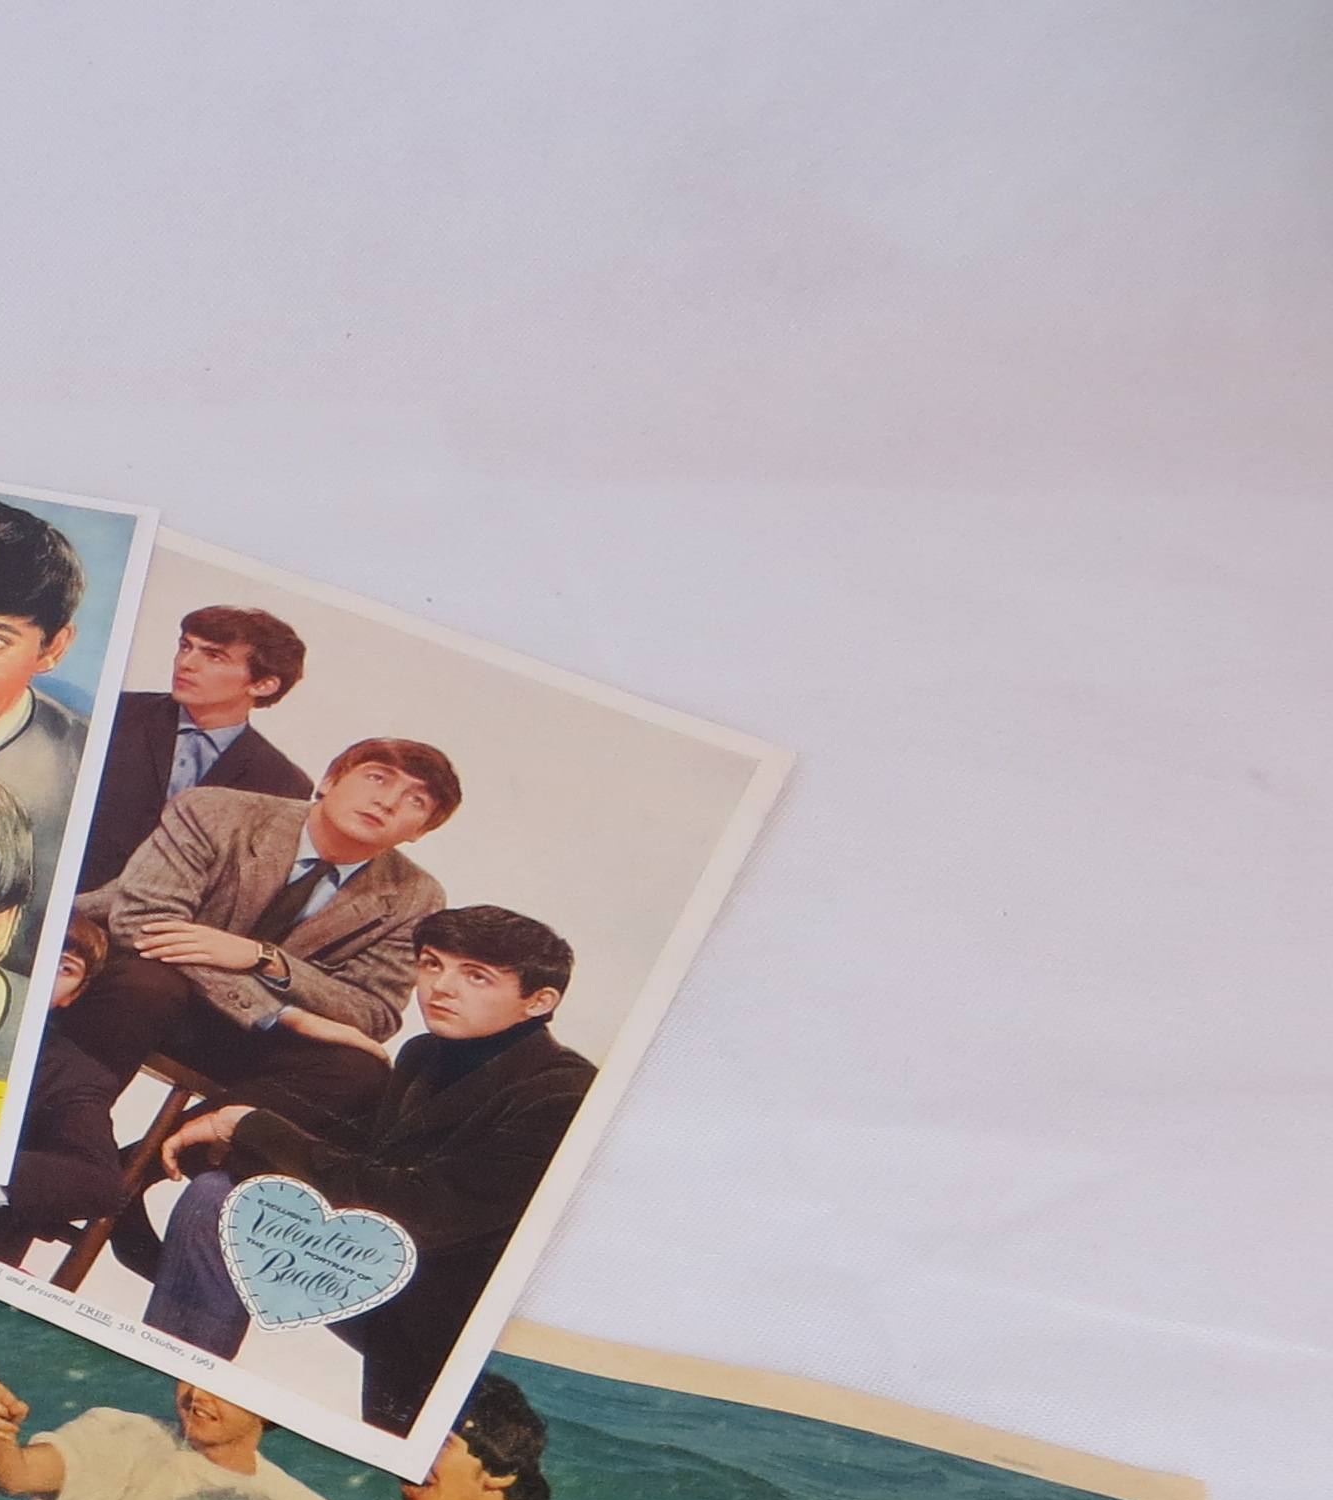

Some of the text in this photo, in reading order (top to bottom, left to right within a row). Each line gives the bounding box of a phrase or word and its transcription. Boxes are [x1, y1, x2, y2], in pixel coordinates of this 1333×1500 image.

[257, 1199, 311, 1225] EXCLUSIVE
[246, 1236, 267, 1249] THE
[251, 1207, 385, 1265] Valentine
[253, 1247, 358, 1302] Beatles
[303, 1250, 373, 1281] PORTRAIT OF
[5, 1275, 27, 1287] and
[27, 1283, 76, 1307] presented
[117, 1322, 136, 1335] 5th
[190, 1354, 216, 1371] 1963
